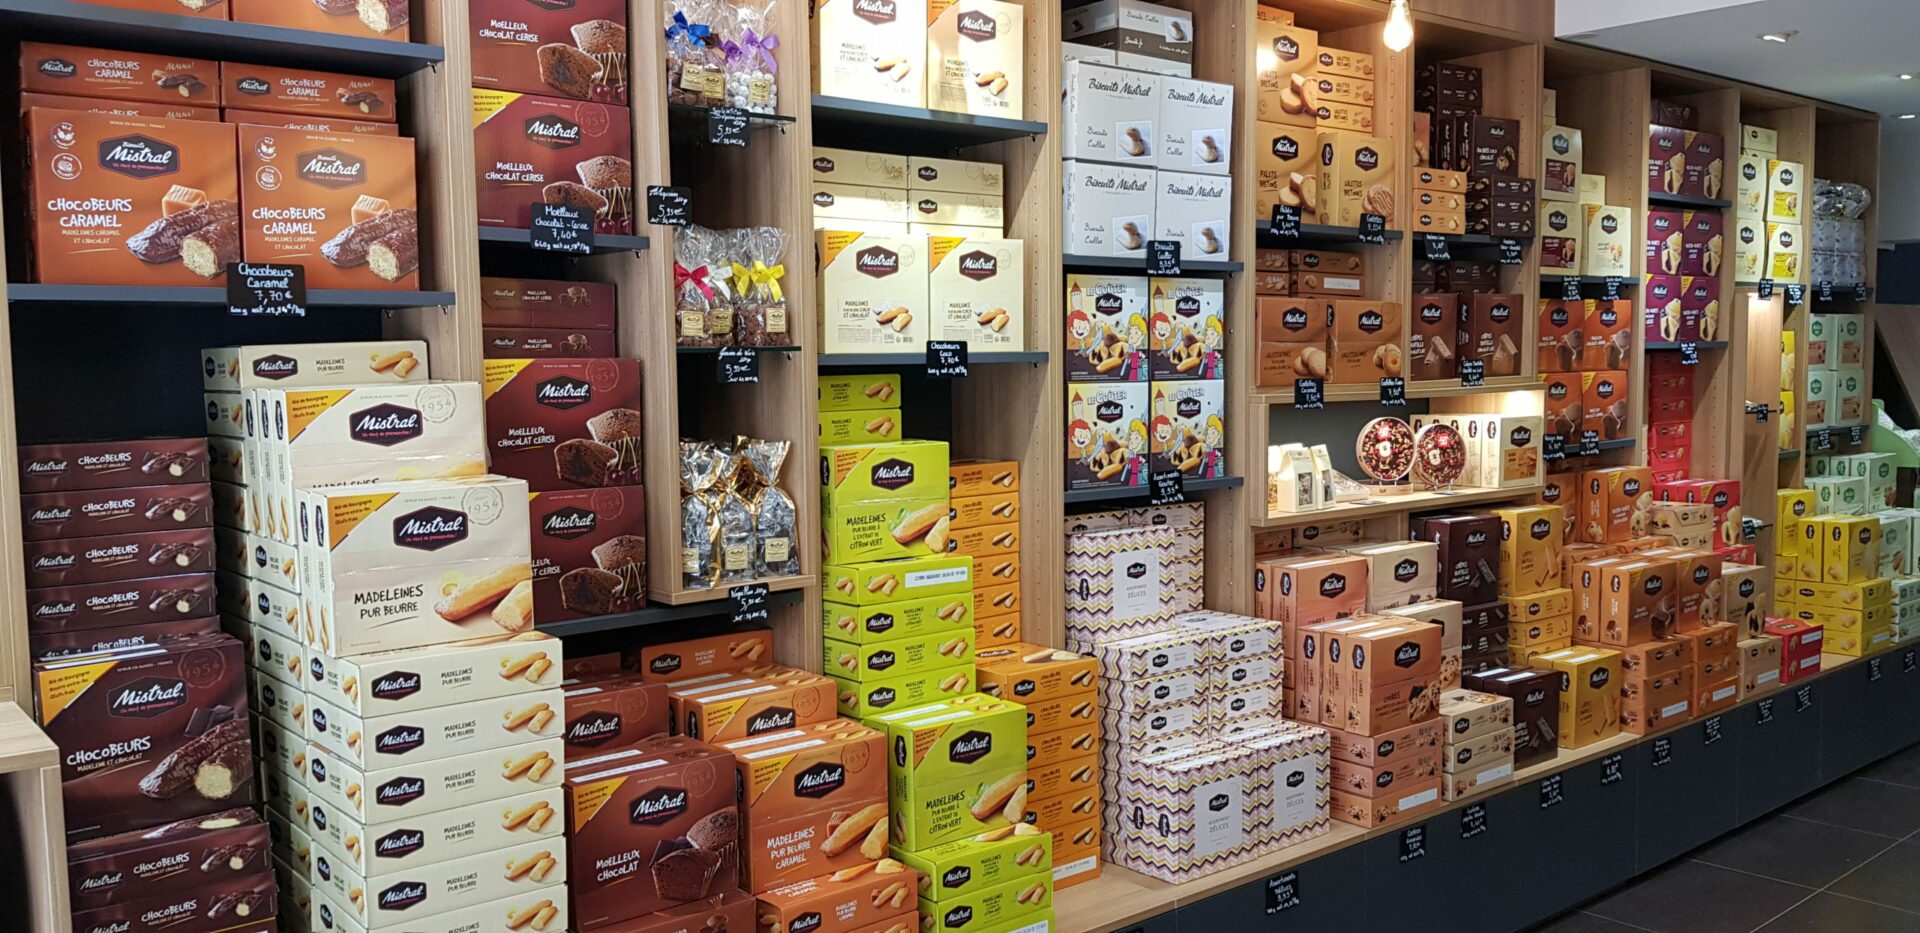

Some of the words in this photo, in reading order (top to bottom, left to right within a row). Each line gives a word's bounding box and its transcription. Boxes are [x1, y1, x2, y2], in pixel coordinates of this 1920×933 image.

[491, 19, 528, 31] MOELLEUX
[479, 29, 514, 41] CHOCOLAT
[516, 31, 539, 42] CERISE
[41, 62, 74, 73] Mistral
[88, 59, 140, 71] CHOCOBEURS
[95, 69, 134, 80] CARAMEL
[239, 81, 268, 91] Mistral
[280, 78, 326, 89] CHOCOBEURS
[1088, 78, 1118, 93] Biscuits
[1120, 83, 1151, 97] Mistral
[287, 87, 320, 97] CARAMEL
[1168, 88, 1195, 102] Biscuits
[1196, 93, 1224, 106] Mistral
[1087, 126, 1108, 136] Biscuits
[106, 146, 172, 165] Mistral
[303, 158, 360, 175] Mistral
[496, 162, 533, 172] MOELLEUX
[485, 172, 521, 181] CHOCOLAT
[522, 173, 545, 182] CERISE
[1085, 176, 1115, 189] Biscuits
[1116, 177, 1147, 191] Mistral
[1167, 183, 1194, 196] Biscuits
[1194, 185, 1223, 198] Mistral
[48, 198, 132, 212] CHOCOBEURS
[545, 205, 579, 218] Moelleux
[252, 207, 326, 220] CHOCOBEURS
[60, 214, 122, 228] CARAMEL
[1084, 222, 1105, 232] Biscuits
[263, 222, 317, 235] CARAMEL
[238, 262, 294, 277] Chocobeurs
[247, 276, 288, 289] Caramel
[1086, 287, 1094, 297] LE
[1095, 283, 1127, 295] GOÛTER
[1167, 290, 1175, 299] LE
[1175, 286, 1204, 298] GOÛTER
[1098, 298, 1121, 309] Mistral
[1178, 301, 1200, 311] Mistral
[256, 360, 295, 372] Mistral
[1087, 396, 1096, 406] LE
[1096, 390, 1127, 403] GOÛTER
[1167, 393, 1176, 402] LE
[1176, 387, 1205, 400] GOÛTER
[420, 398, 452, 412] 1954
[1099, 406, 1122, 416] Mistral
[1179, 402, 1200, 412] Mistral
[508, 427, 545, 436] MOELLEUX
[497, 437, 531, 447] CHOCOLAT
[534, 435, 556, 445] CERISE
[78, 452, 132, 465] CHOCOBEURS
[27, 461, 68, 472] Mistral
[82, 498, 135, 512] CHOCOBEURS
[468, 500, 500, 514] 1954
[32, 509, 72, 520] Mistral
[846, 513, 886, 526] MADELEINES
[850, 540, 869, 550] CITRON
[869, 538, 883, 547] VERT
[86, 544, 139, 559] CHOCOBEURS
[35, 555, 76, 567] Mistral
[539, 565, 561, 575] CERISE
[86, 591, 140, 606] CHOCOBEURS
[354, 584, 423, 606] MADELEINES
[1127, 589, 1147, 599] DÉLICES
[36, 603, 76, 615] Mistral
[360, 606, 382, 619] PUR
[384, 602, 419, 616] BEURRE
[375, 677, 418, 692] Mistral
[379, 732, 421, 747] Mistral
[66, 735, 151, 766] CHOCOBEURS
[77, 760, 106, 772] MADELEINE
[114, 752, 142, 764] CHOCOLAT
[380, 784, 422, 800] Mistral
[926, 791, 965, 809] MADELEINES
[931, 808, 941, 817] PUR
[929, 823, 948, 834] CITRON
[948, 818, 962, 830] VERT
[1209, 821, 1230, 833] DÉLICES
[379, 836, 421, 852] Mistral
[767, 826, 815, 848] MADELEINES
[771, 848, 786, 860] PUR
[787, 841, 811, 856] BEURRE
[133, 852, 190, 874] CHOCOBEURS
[596, 850, 640, 869] MOELLEUX
[776, 855, 807, 870] CARAMEL
[597, 861, 639, 882] CHOCOLAT
[80, 872, 123, 890] Mistral
[382, 888, 424, 904] Mistral
[141, 899, 197, 923] CHOCOBEURS
[791, 914, 820, 931] Mistral
